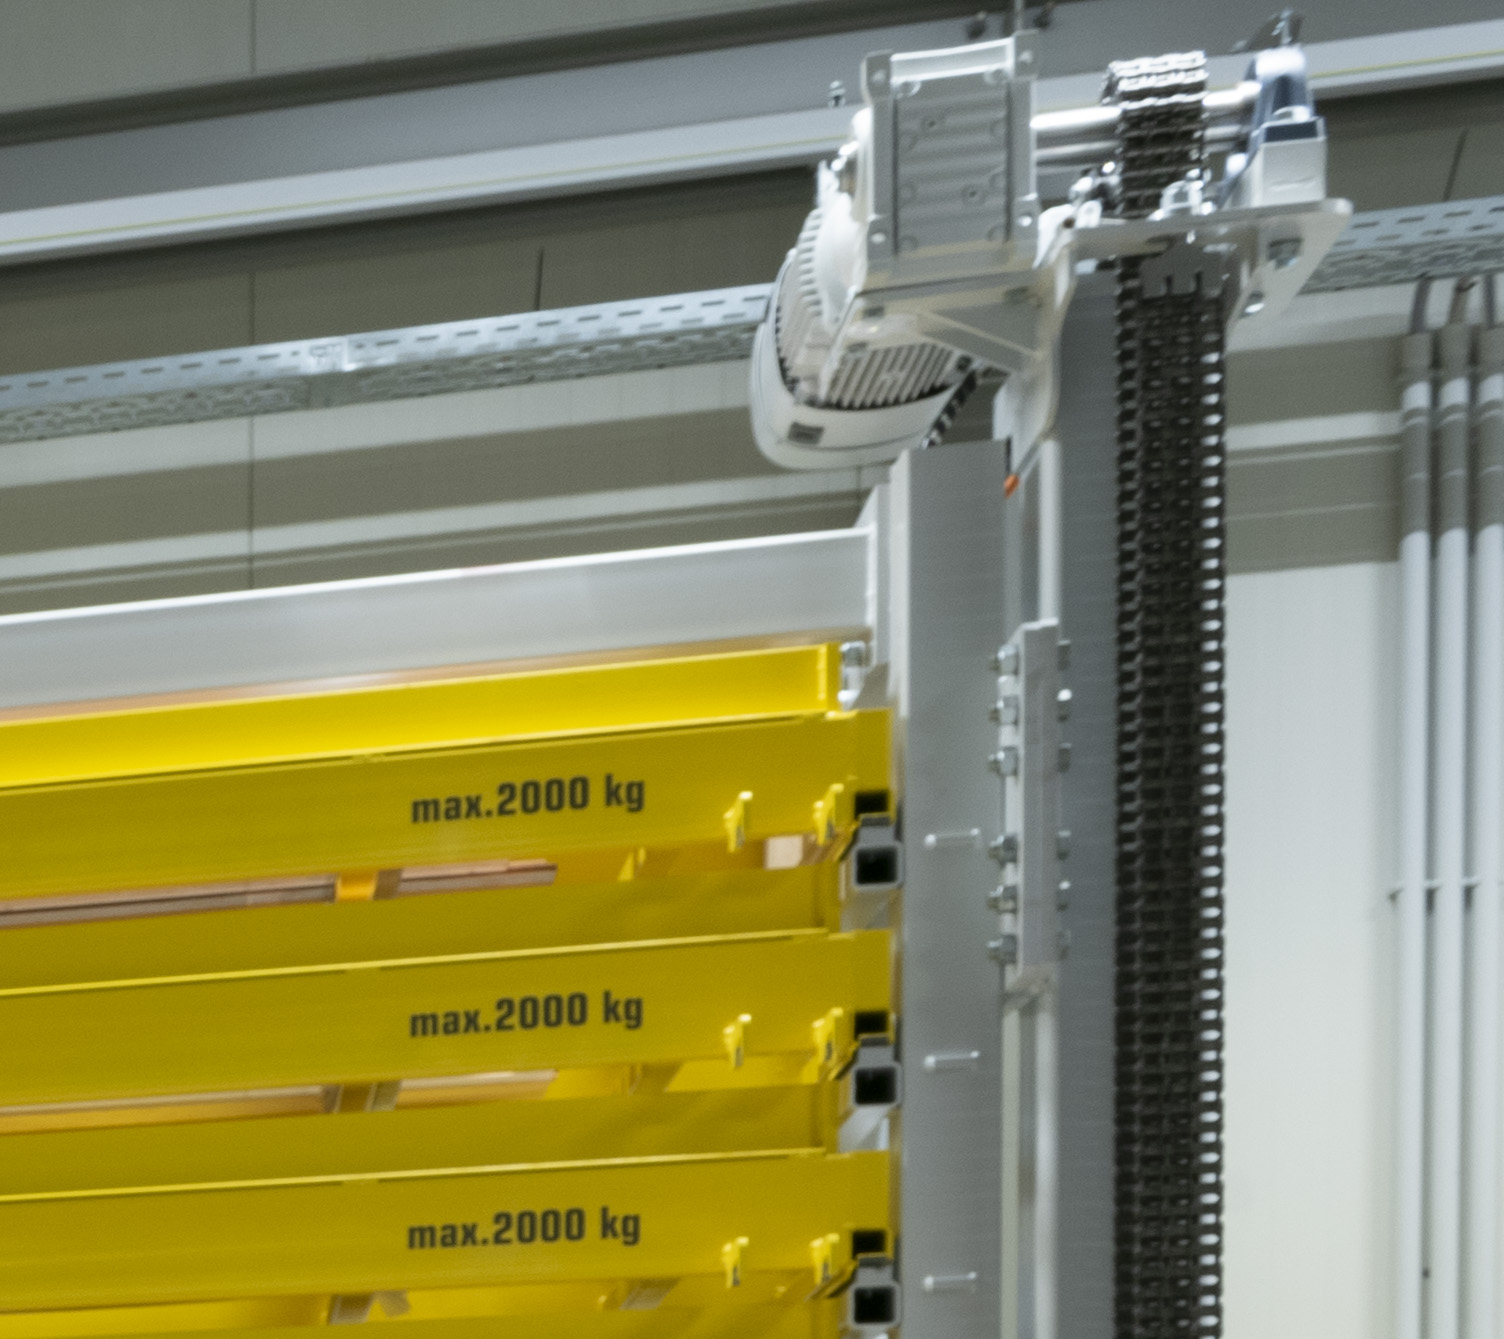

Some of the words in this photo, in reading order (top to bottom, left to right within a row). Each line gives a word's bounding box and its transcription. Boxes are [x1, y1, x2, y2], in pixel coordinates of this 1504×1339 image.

[412, 776, 590, 823] max.2000
[604, 774, 645, 813] kg
[410, 993, 588, 1037] max.2000
[603, 991, 643, 1030] kg
[408, 1208, 585, 1249] max.2000
[601, 1206, 640, 1246] kg
